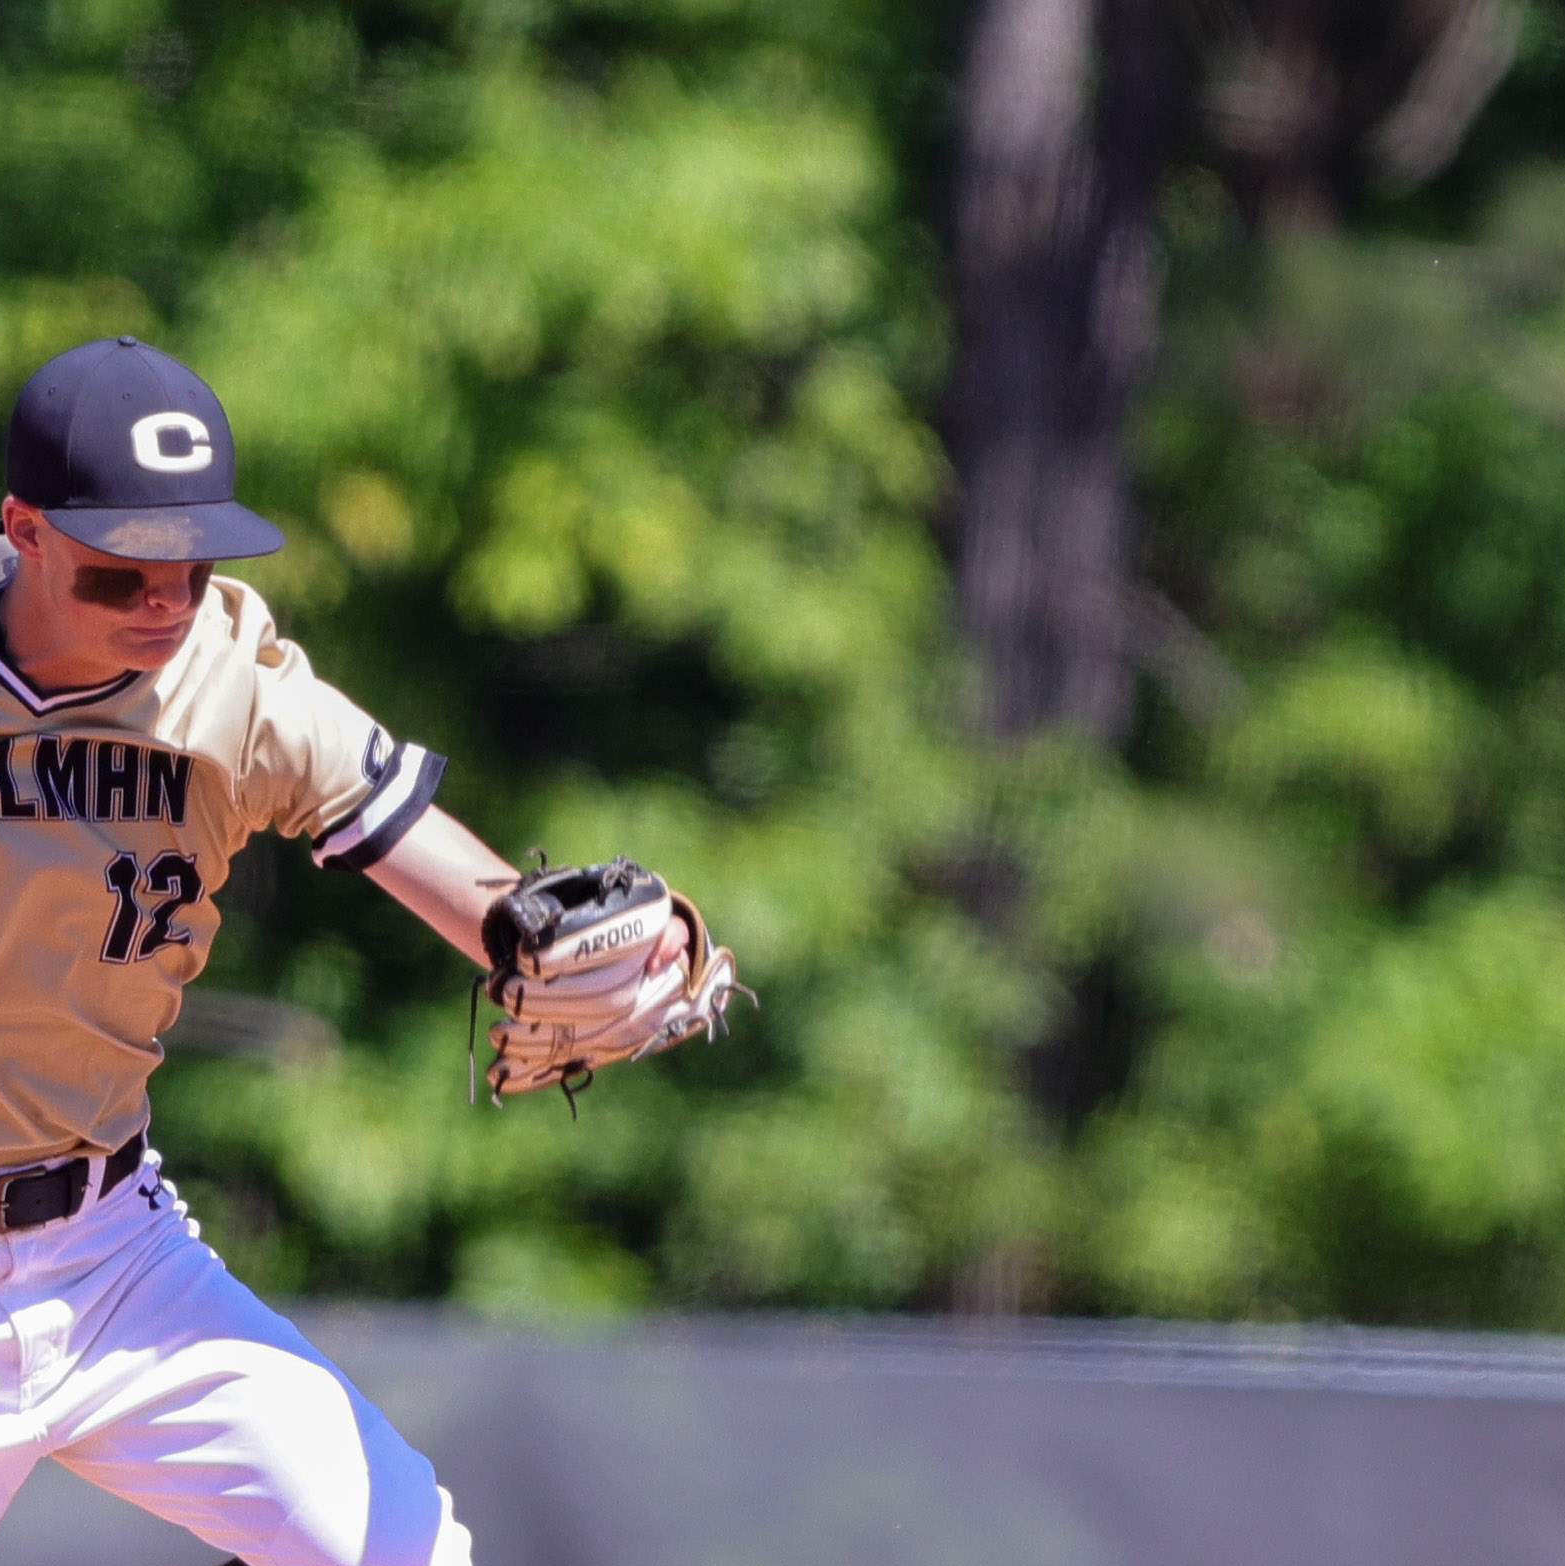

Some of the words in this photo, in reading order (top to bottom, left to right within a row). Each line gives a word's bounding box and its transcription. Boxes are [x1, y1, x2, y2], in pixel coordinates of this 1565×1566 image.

[130, 411, 212, 473] C
[100, 849, 205, 964] 12
[574, 919, 644, 962] A2000
